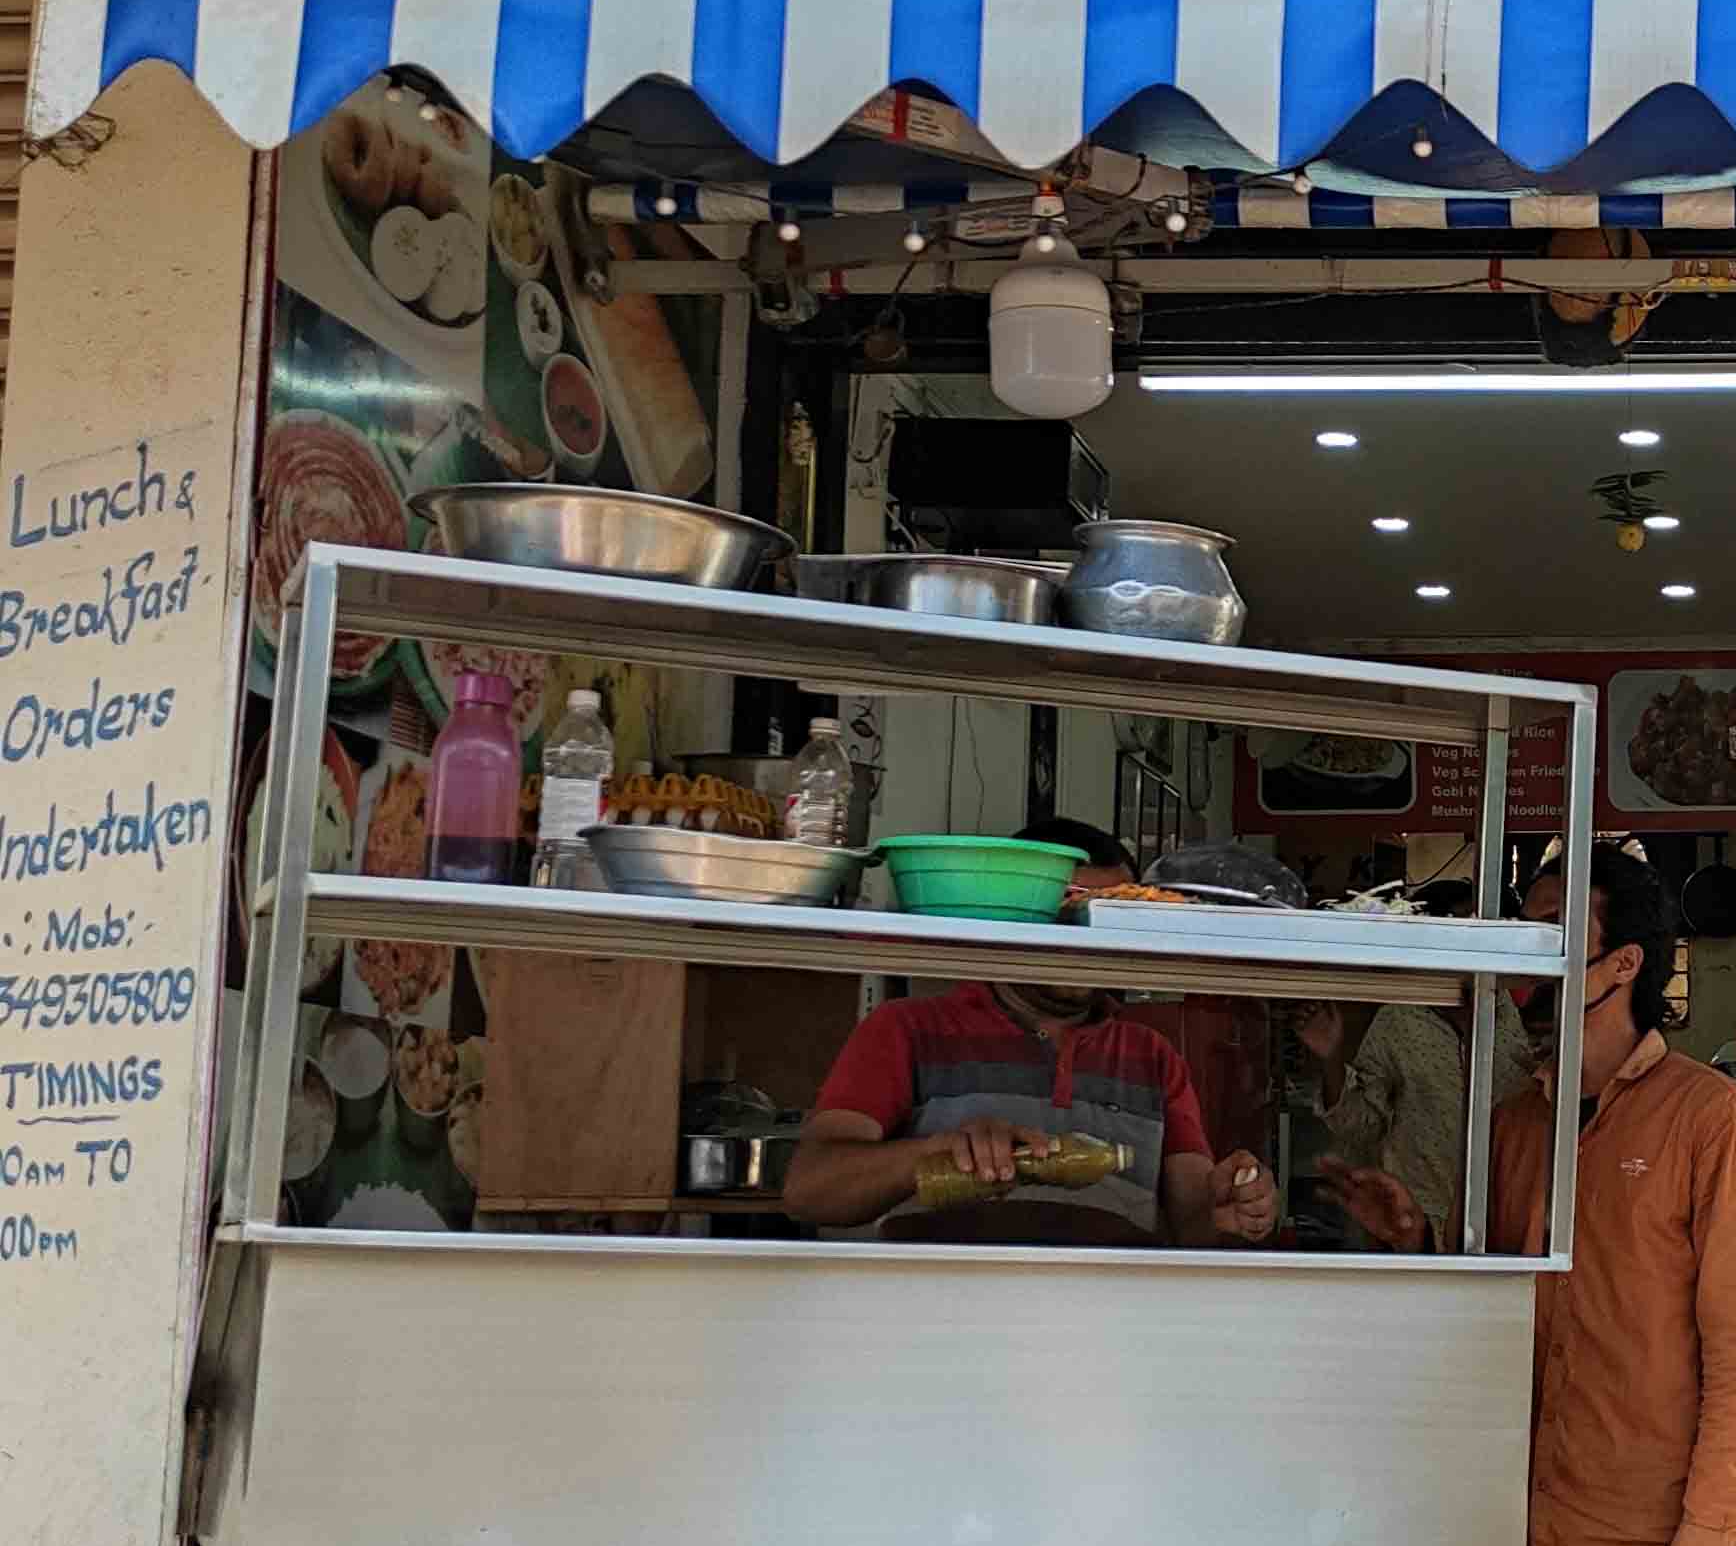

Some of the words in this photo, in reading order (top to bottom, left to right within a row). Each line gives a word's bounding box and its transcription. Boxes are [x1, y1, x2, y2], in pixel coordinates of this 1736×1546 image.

[10, 437, 166, 548] Lunch
[175, 469, 196, 521] &
[2, 676, 176, 762] Orders
[0, 780, 212, 881] ndertaken
[1, 1055, 164, 1110] TIMINGS
[75, 1137, 131, 1188] TO
